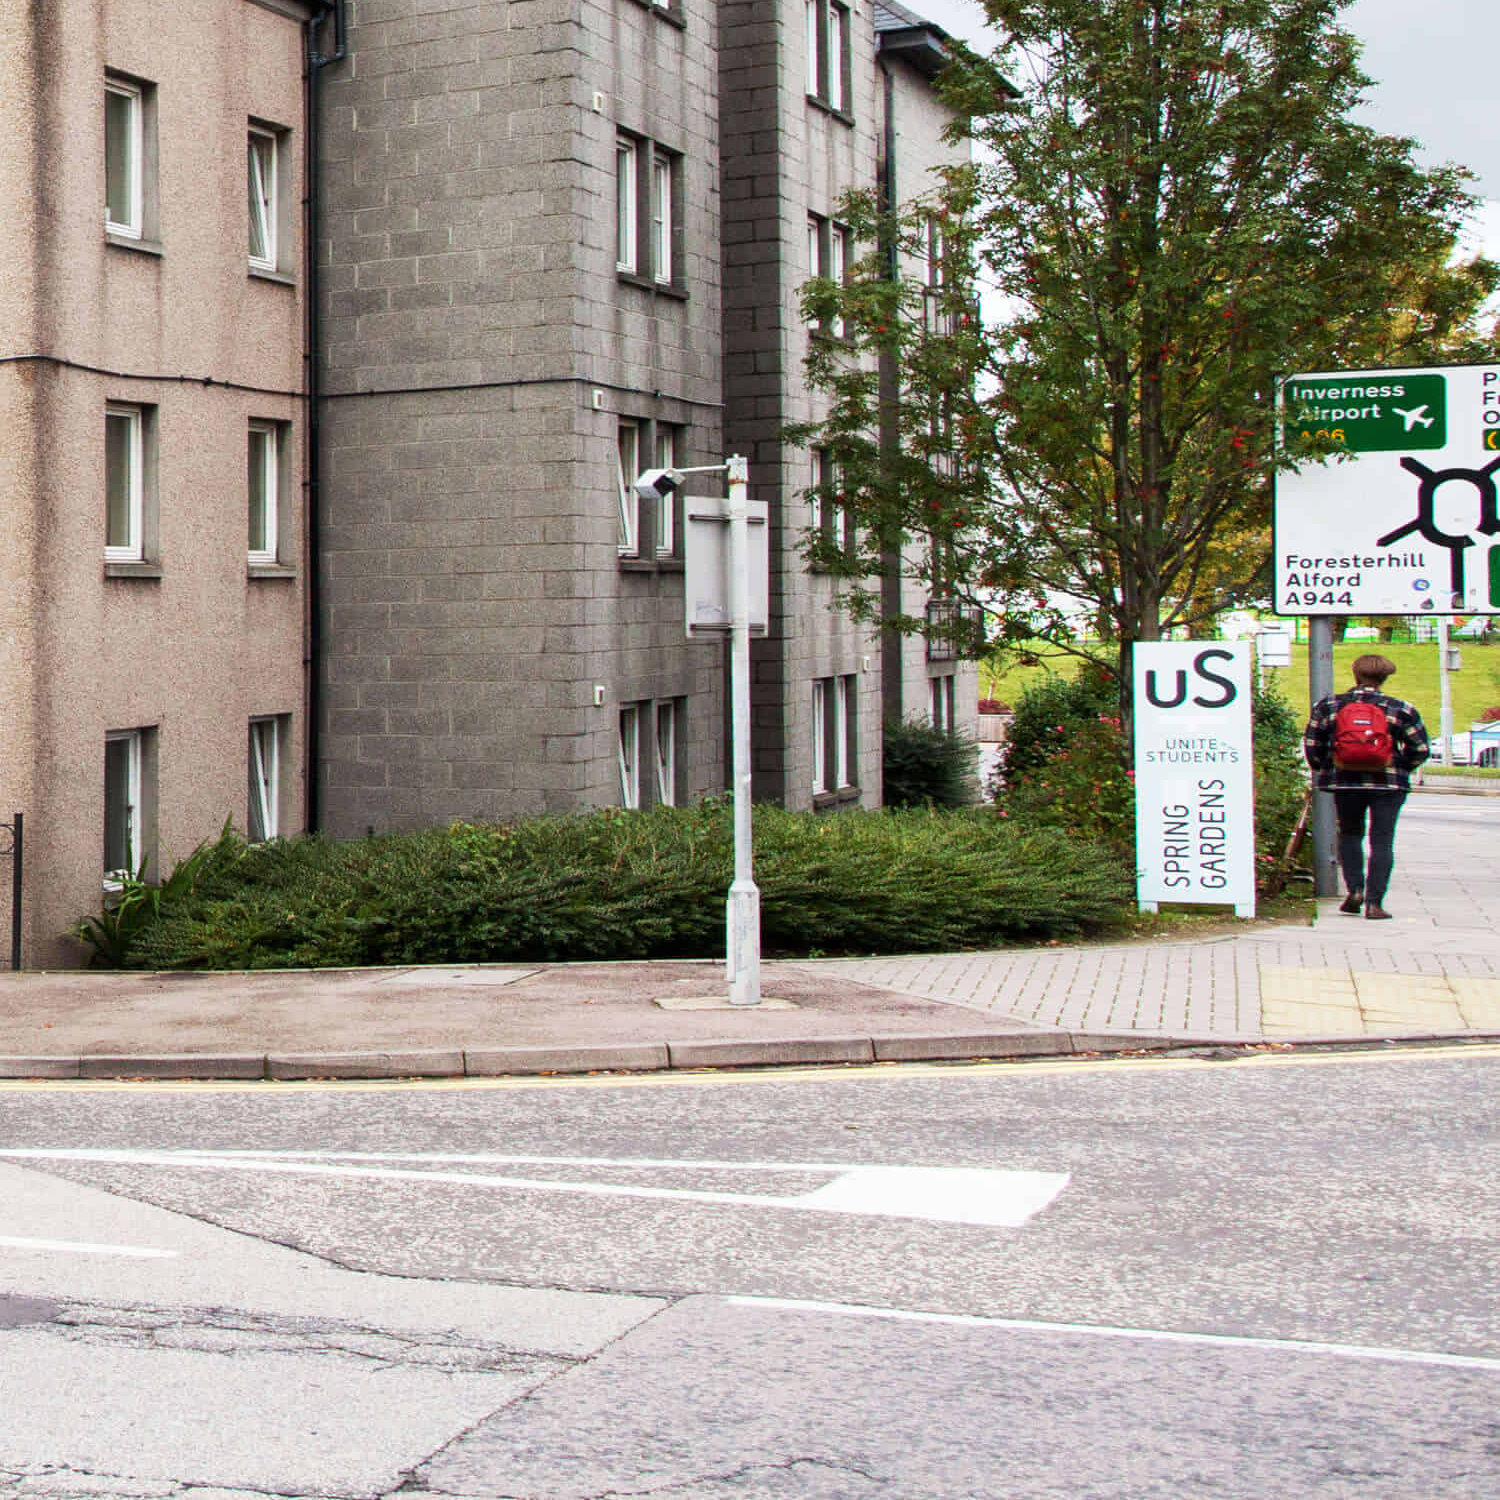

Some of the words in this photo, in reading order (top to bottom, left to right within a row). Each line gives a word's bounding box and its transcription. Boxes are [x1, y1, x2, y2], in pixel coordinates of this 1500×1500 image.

[1293, 384, 1405, 400] Inverness
[1297, 403, 1382, 423] Airport
[1286, 553, 1426, 569] Foresterhill
[1286, 572, 1361, 588] Alford
[1285, 590, 1354, 607] A944
[1165, 738, 1218, 750] UNITE
[1146, 750, 1240, 764] STUDENTS
[1198, 779, 1227, 889] GARDENS
[1163, 804, 1191, 888] SPRING
